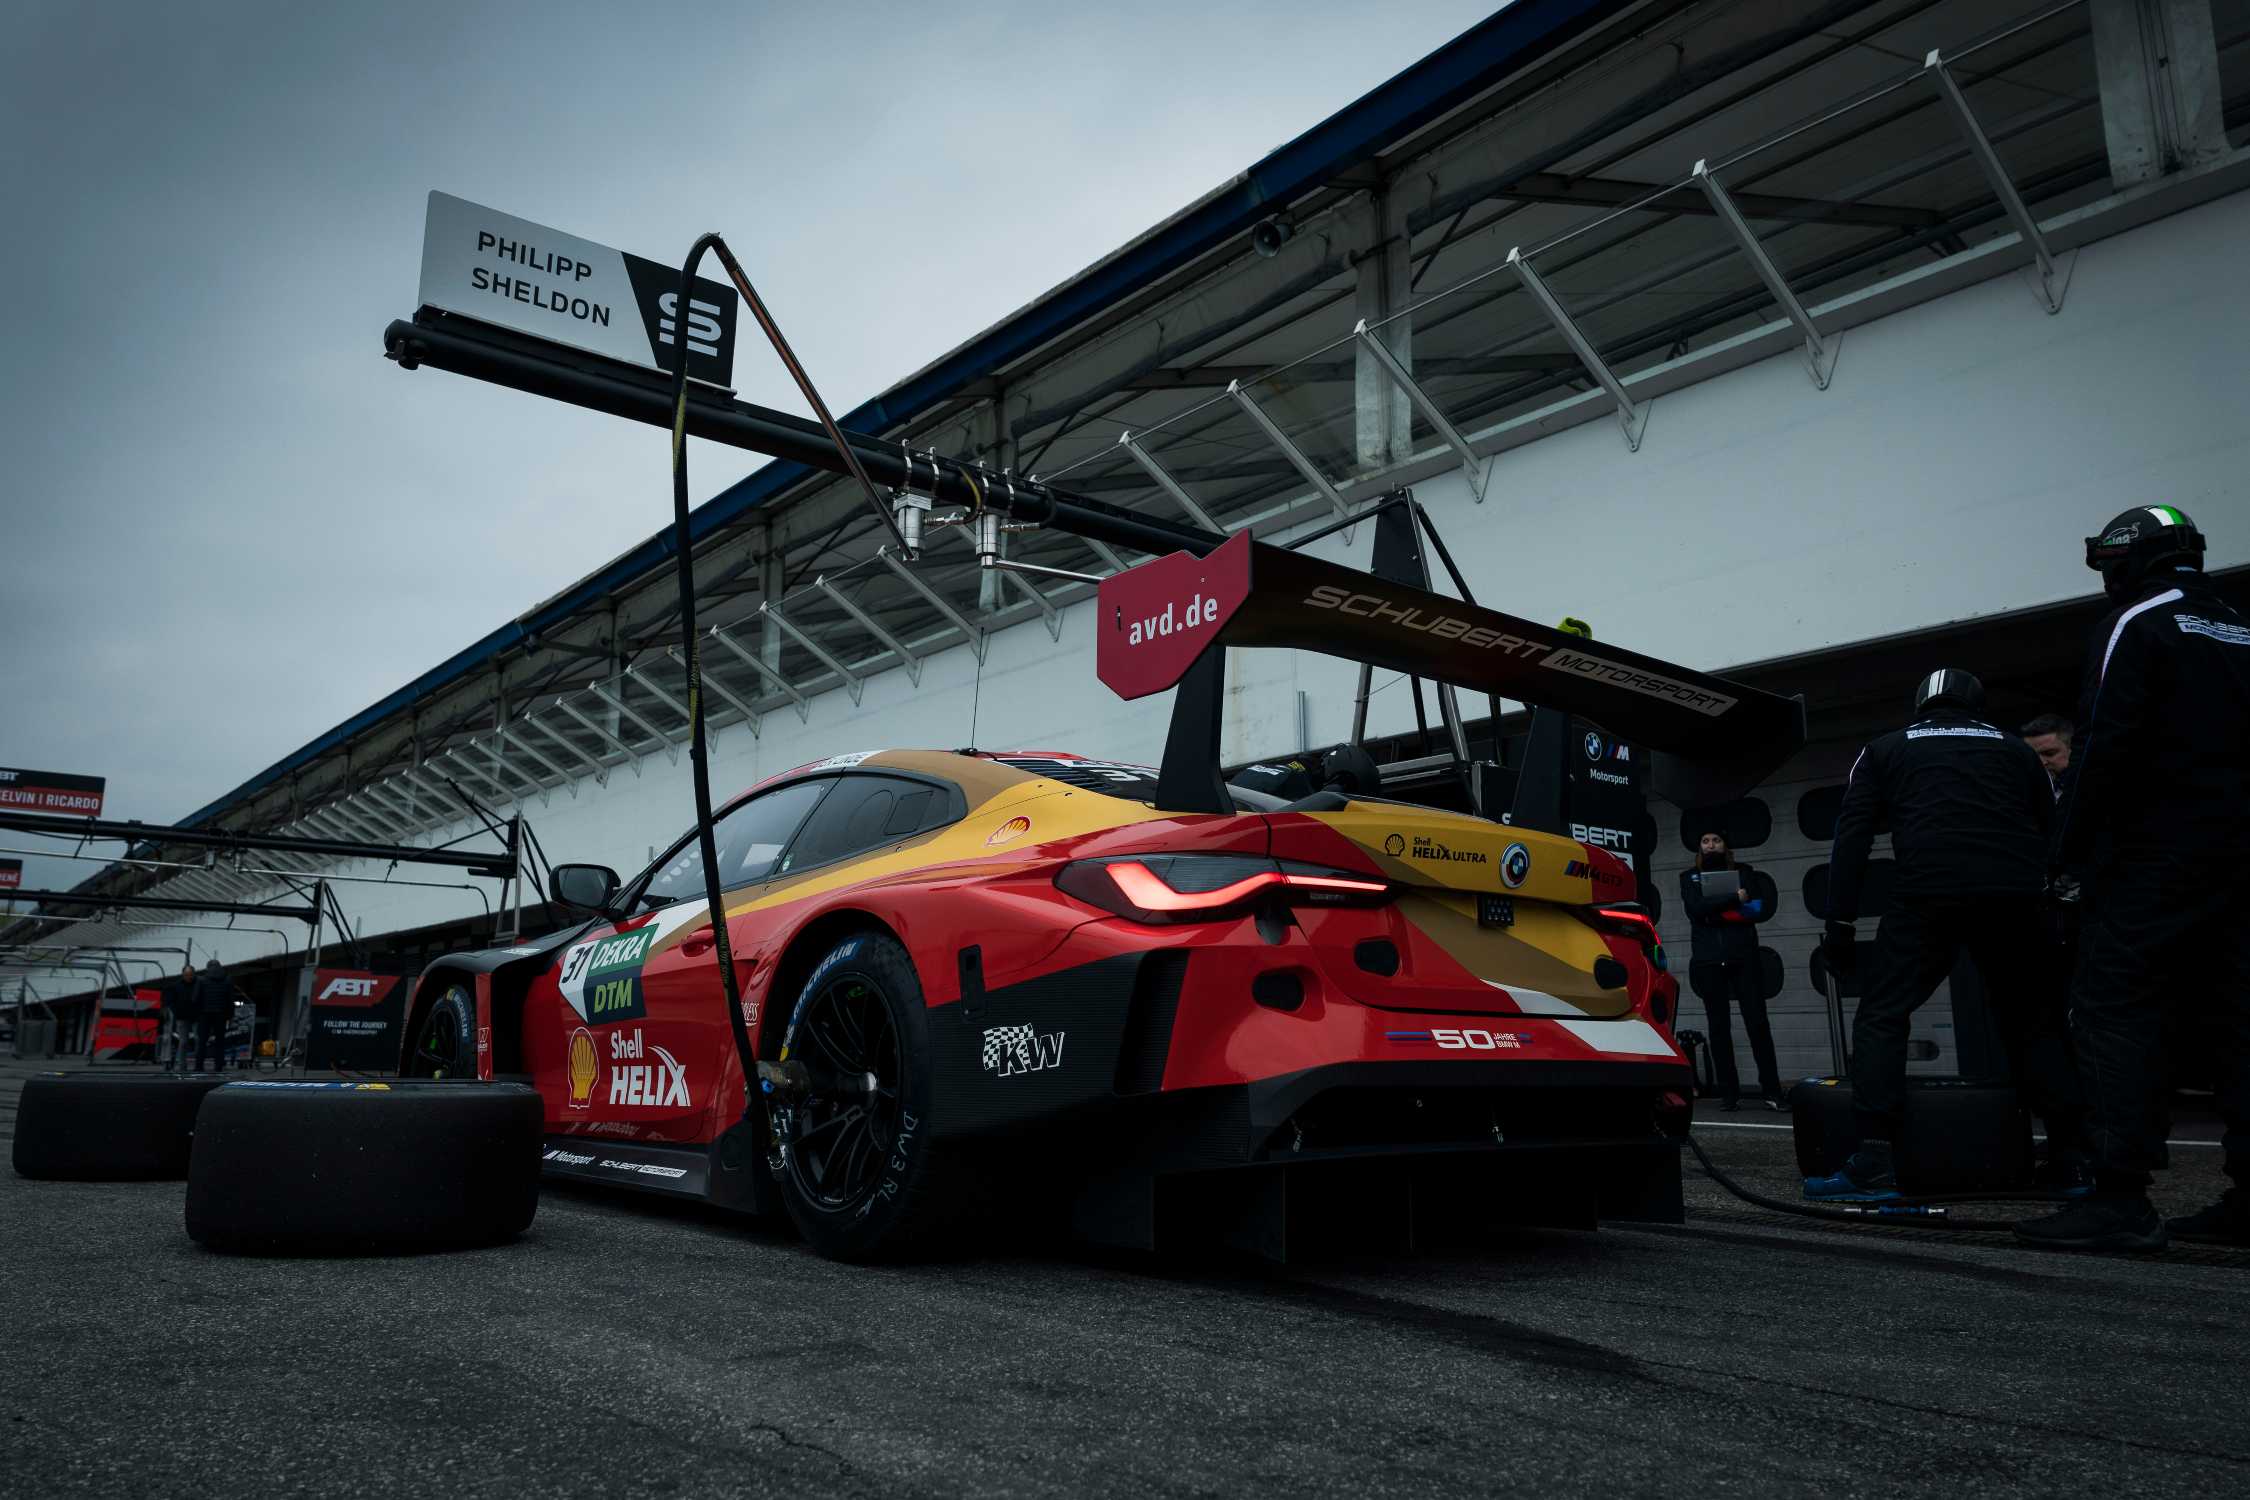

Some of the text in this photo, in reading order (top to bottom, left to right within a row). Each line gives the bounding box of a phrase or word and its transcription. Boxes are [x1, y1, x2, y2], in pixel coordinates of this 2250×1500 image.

[477, 230, 593, 283] PHILIPP
[471, 267, 611, 327] SHELDON
[1129, 593, 1218, 646] avd.de
[1303, 585, 1726, 710] SCHUBERT MOTORSPORT
[0, 771, 20, 781] BT
[1589, 767, 1630, 785] Motorsport
[0, 790, 35, 805] ELVIN
[46, 793, 99, 811] RICARDO
[1412, 844, 1488, 864] HELIX ULTRA
[1414, 836, 1432, 847] Shell
[562, 932, 649, 984] 31 DEKRA
[317, 977, 379, 1000] ABT
[593, 977, 633, 1014] DTM
[610, 1028, 644, 1060] Shell
[997, 1031, 1066, 1078] KW
[1431, 1029, 1496, 1050] 50
[609, 1046, 692, 1107] HELIX
